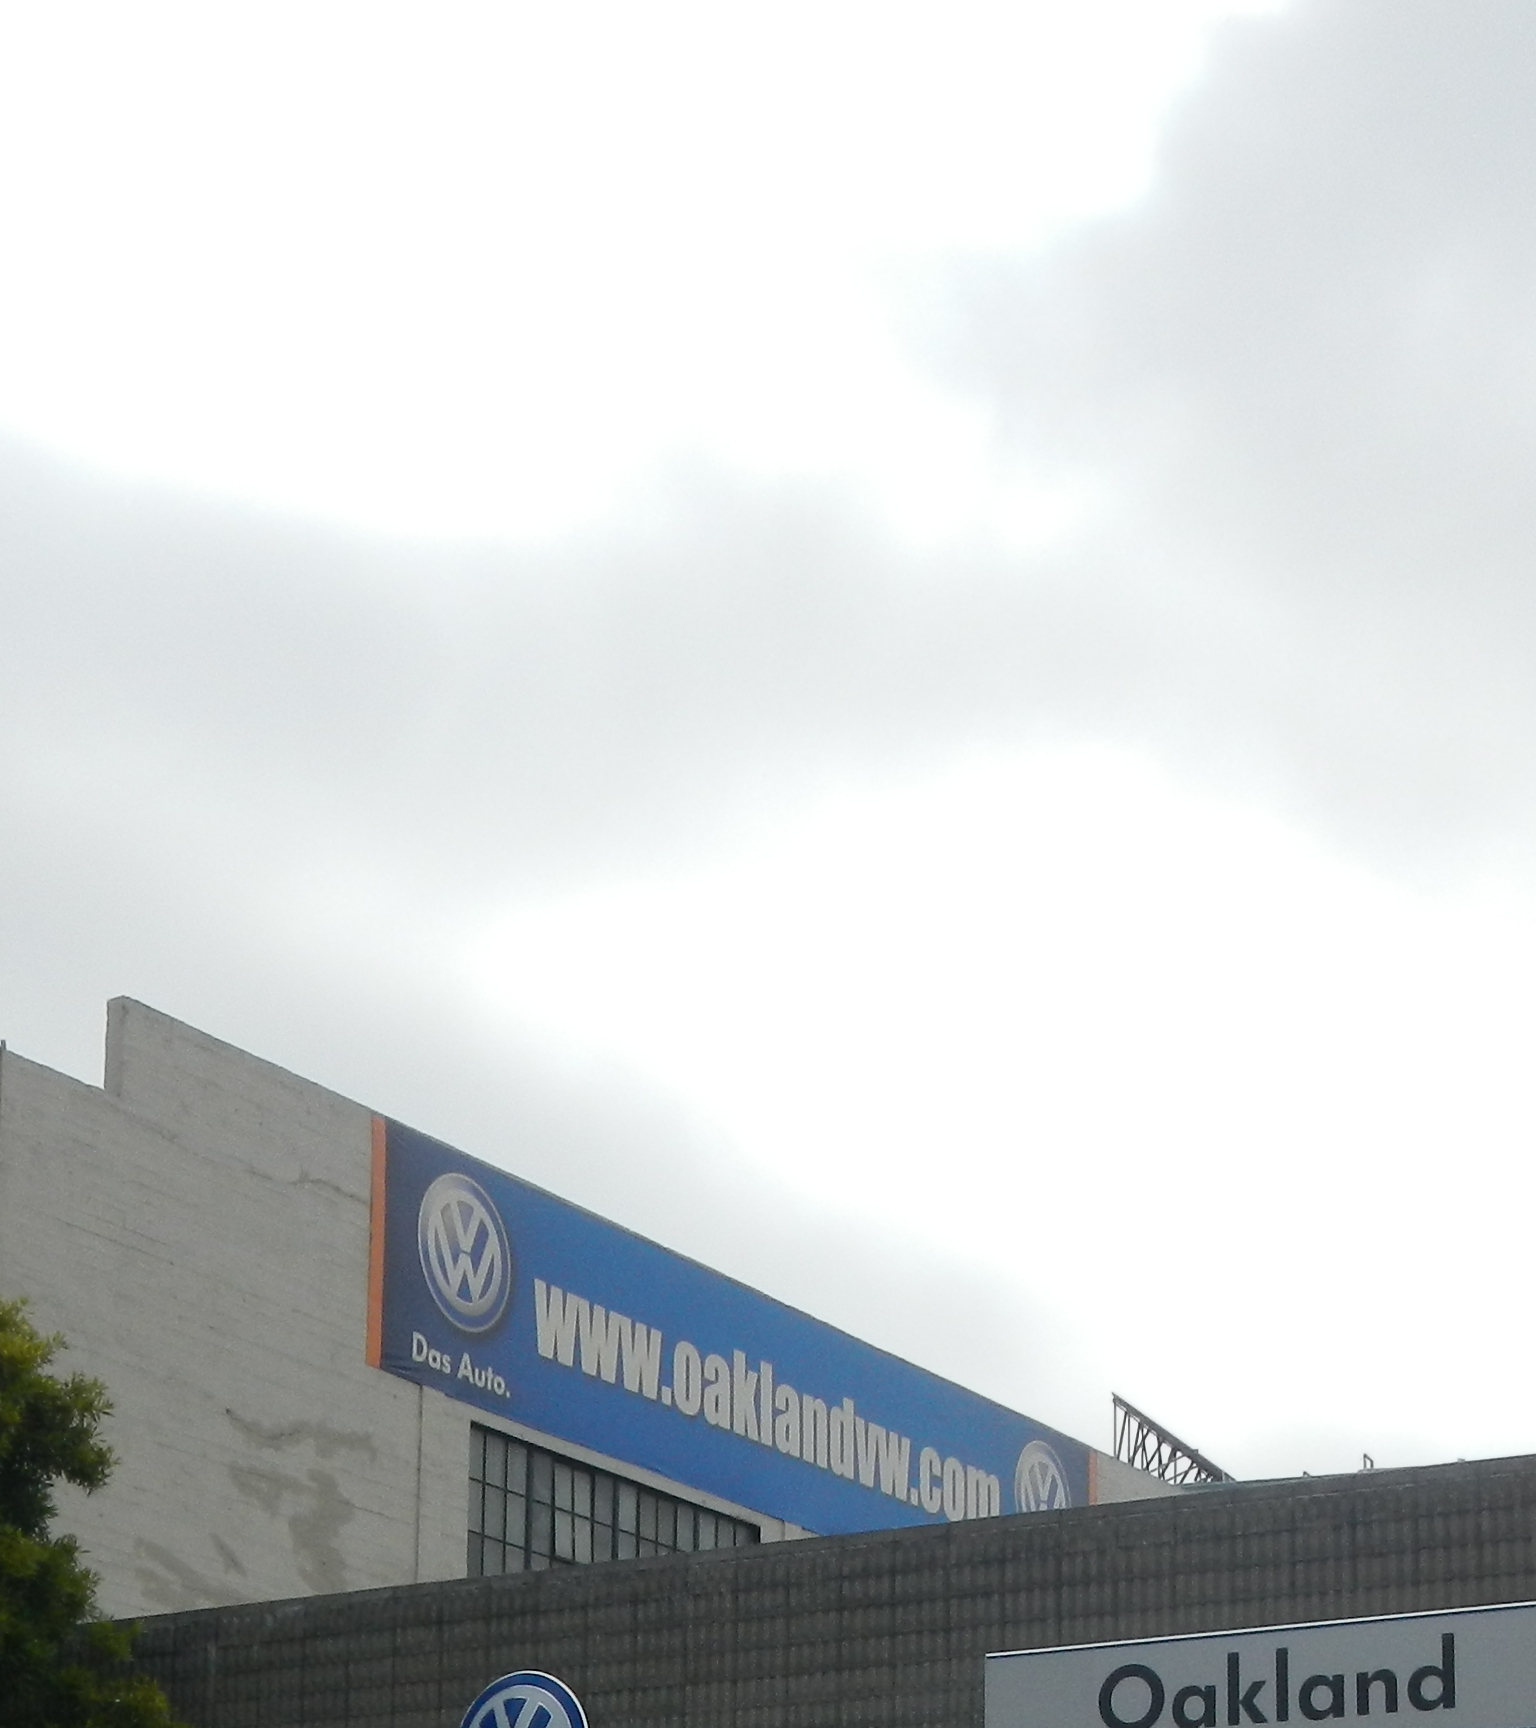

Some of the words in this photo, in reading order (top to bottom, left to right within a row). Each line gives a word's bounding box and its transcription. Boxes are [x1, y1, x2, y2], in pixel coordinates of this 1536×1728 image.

[411, 1331, 452, 1375] Das
[457, 1352, 512, 1399] Auto.
[533, 1277, 1001, 1522] www.oaklandvw.com
